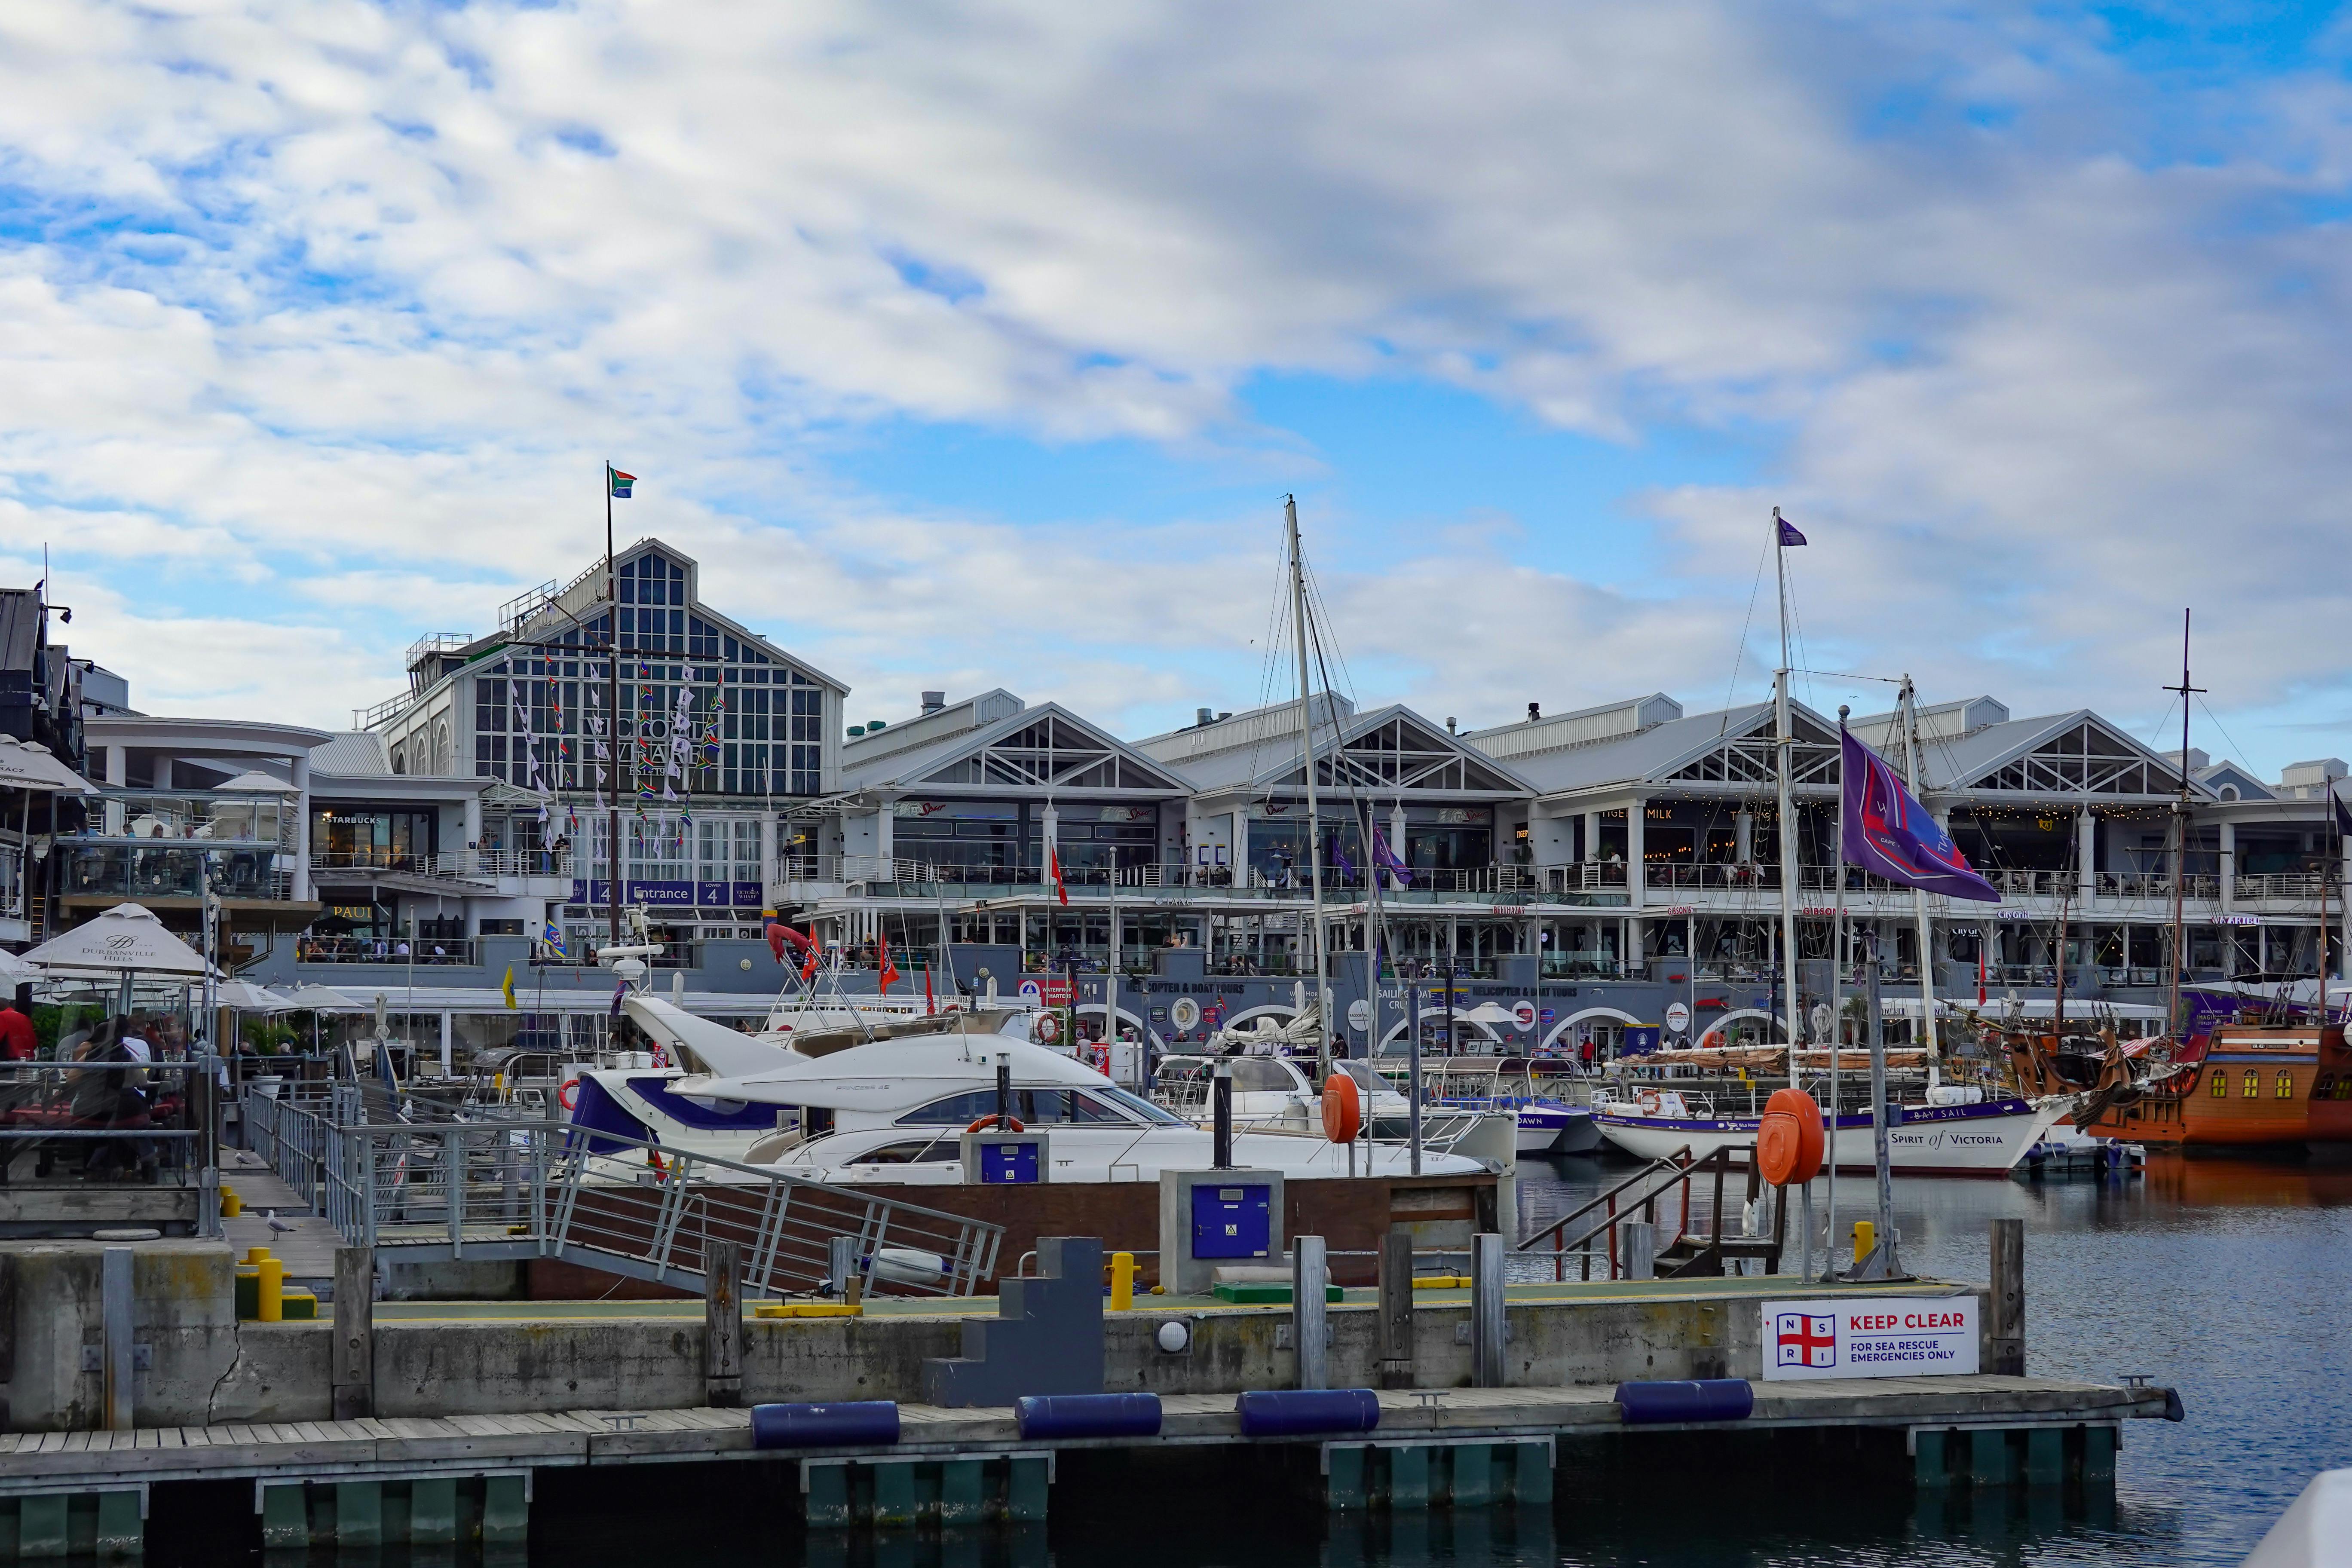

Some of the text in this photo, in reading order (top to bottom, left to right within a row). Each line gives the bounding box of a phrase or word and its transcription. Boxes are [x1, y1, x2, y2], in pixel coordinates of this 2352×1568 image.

[919, 802, 946, 816] Spur
[1126, 807, 1152, 821] Spur
[1647, 809, 1672, 819] MILK
[1462, 809, 1488, 822] Spur
[1516, 830, 1528, 838] TIGER
[1880, 837, 1896, 847] CAPE
[600, 887, 611, 902] 4
[634, 886, 688, 899] Entrance
[707, 888, 717, 903] 4
[1164, 897, 1193, 906] TANG
[334, 906, 372, 918] PAUL
[1493, 906, 1525, 914] BELTHAZAR
[1668, 906, 1691, 915] GIBSON'S
[82, 947, 156, 957] DURBANVILLE
[1126, 982, 1244, 994] HELCOPTER & BOAT TOURS
[1473, 986, 1577, 997] HELICOPTER & BOAT TOURS
[1378, 990, 1409, 998] SAILIG
[1914, 1109, 1966, 1120] BAY SAIL
[1929, 1130, 1945, 1150] of
[1786, 1320, 1825, 1332] N S
[1850, 1313, 1964, 1330] KEEP CLEAR
[1851, 1341, 1939, 1351] FOR SEA RESCUE
[1787, 1349, 1824, 1362] R I
[1851, 1351, 1955, 1362] EMERGENCIES ONLY
